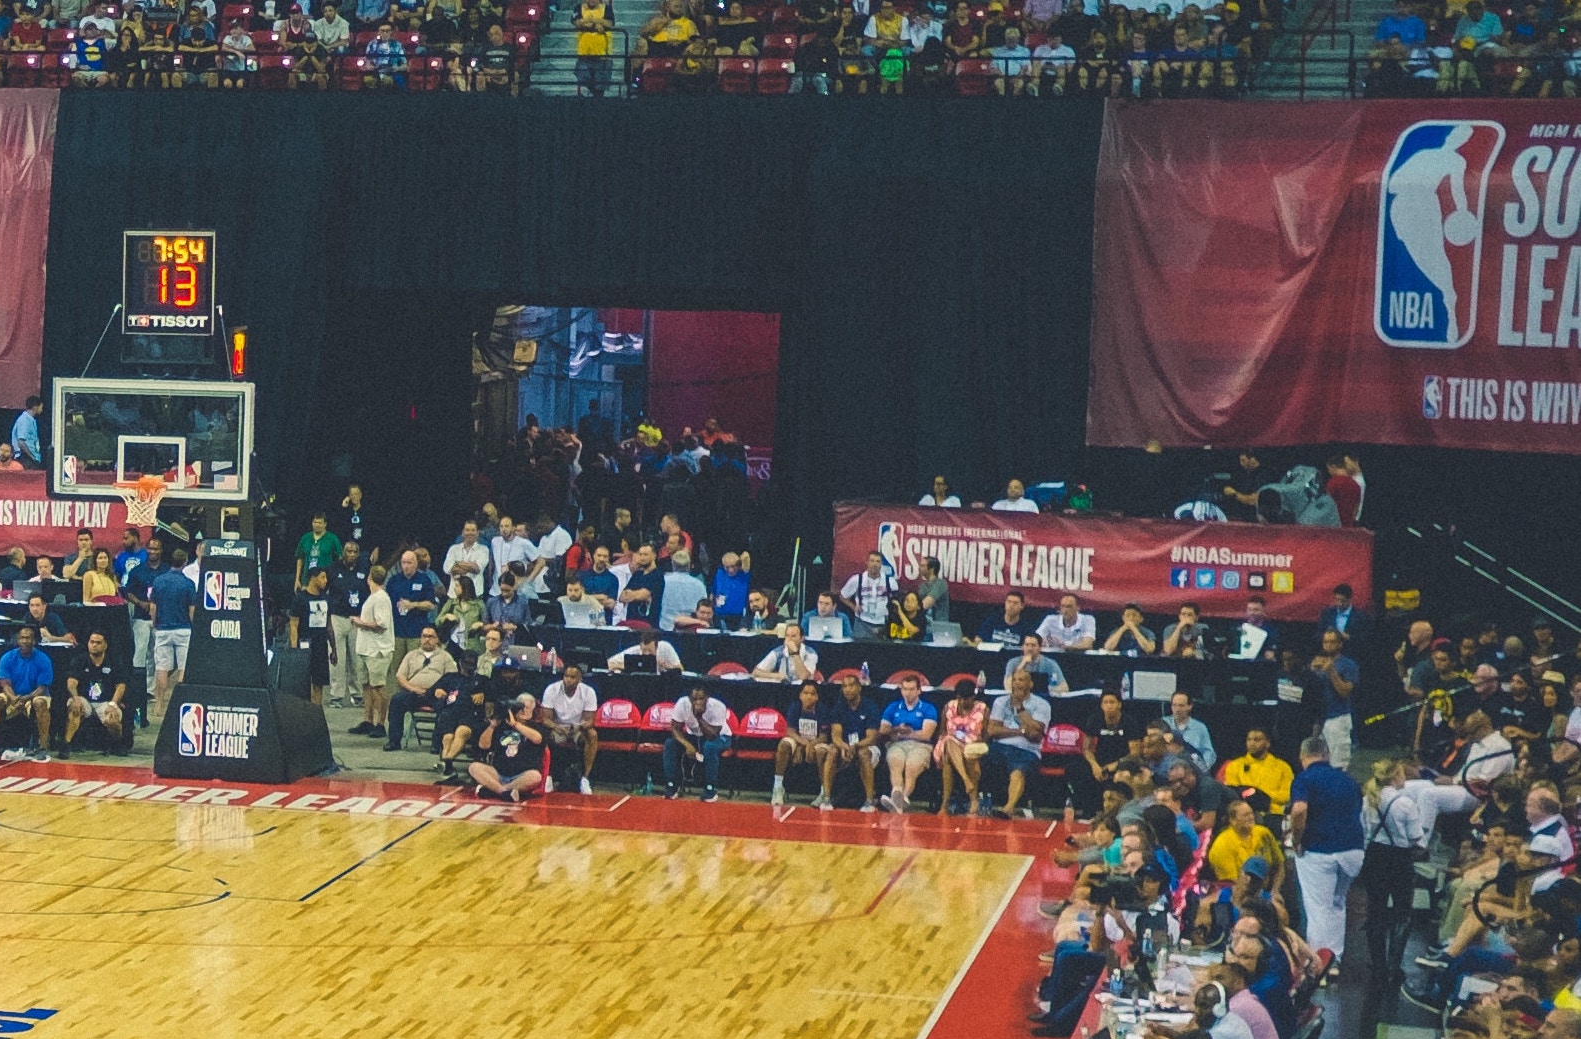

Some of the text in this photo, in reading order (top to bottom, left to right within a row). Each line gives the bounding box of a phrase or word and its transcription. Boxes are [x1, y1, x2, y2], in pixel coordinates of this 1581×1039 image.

[1529, 124, 1571, 138] MGM
[153, 236, 205, 264] 7:54
[158, 264, 199, 308] 13
[150, 315, 209, 328] TISSOT
[1388, 290, 1434, 330] NBA
[1447, 377, 1499, 420] THIS
[1502, 380, 1527, 422] IS
[16, 500, 50, 527] WHY
[51, 501, 73, 528] WE
[74, 501, 110, 528] PLAY
[1010, 542, 1095, 592] LEAGUE
[1170, 544, 1294, 569] #NBASummer
[210, 619, 241, 640] @NBA
[205, 711, 259, 737] SUMMER
[205, 735, 249, 760] LEAGUE
[263, 791, 523, 823] LEAGUE
